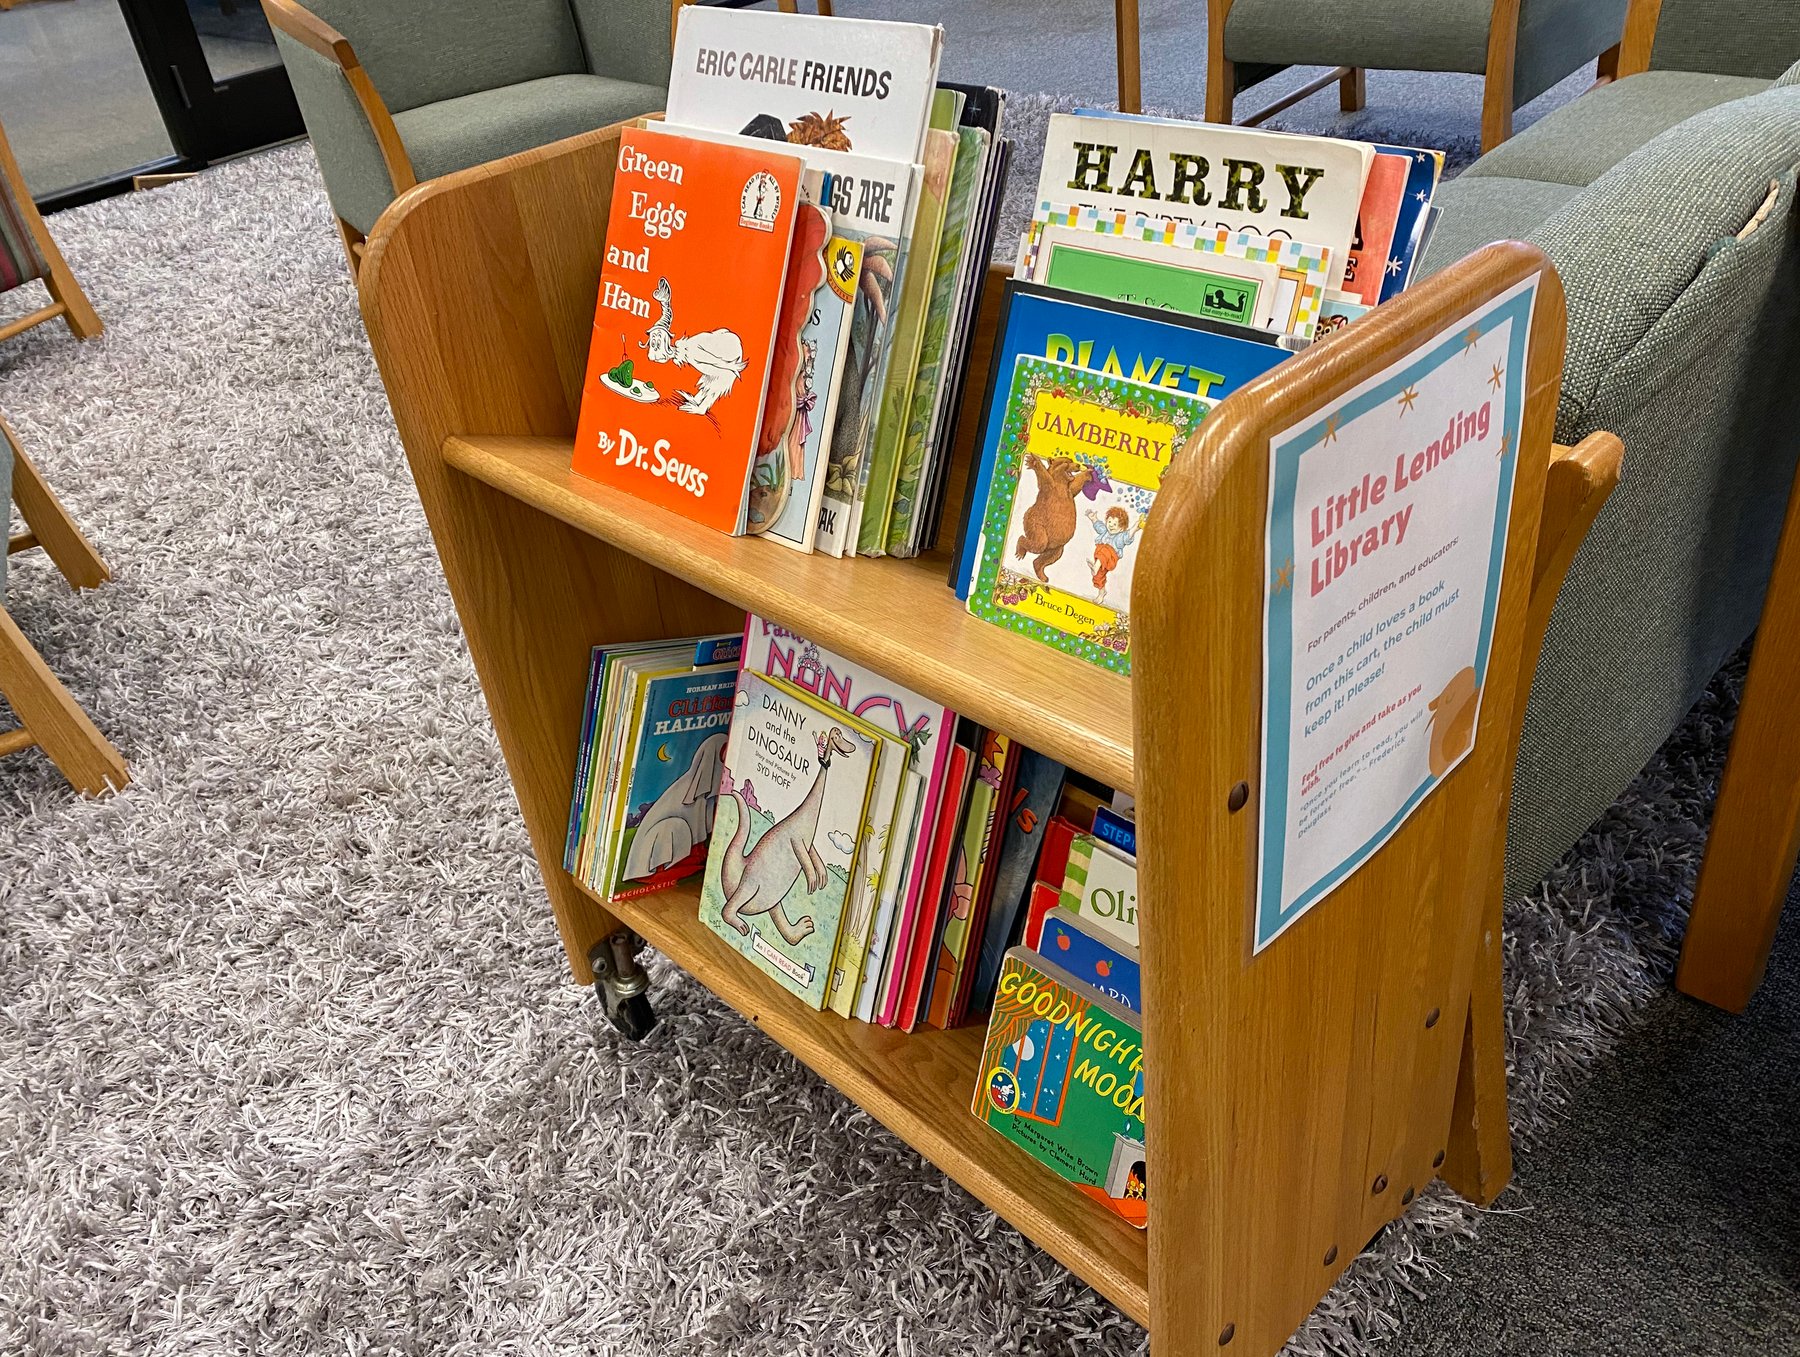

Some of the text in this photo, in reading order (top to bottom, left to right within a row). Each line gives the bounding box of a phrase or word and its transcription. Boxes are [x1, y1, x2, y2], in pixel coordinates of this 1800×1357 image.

[696, 48, 892, 100] ERIC CARLE FRIENDS
[618, 145, 684, 186] Green
[1066, 141, 1325, 220] HARRY
[628, 190, 687, 239] Eggs
[856, 179, 896, 223] ARE
[606, 244, 650, 273] and
[601, 281, 651, 319] Ham
[1036, 411, 1167, 462] JAMBERRY
[598, 428, 709, 498] By Dr. Seuss
[1311, 401, 1491, 548] Little Lending
[1310, 503, 1414, 598] Library
[1034, 592, 1095, 625] Bruce Degen
[1307, 536, 1460, 652] For parents, children, and educators:
[1305, 588, 1460, 716] from this cart, the child must
[1306, 579, 1446, 691] Once a child loves a book
[686, 682, 736, 694] NORMAN BRID
[762, 693, 806, 730] DANNY
[1304, 662, 1386, 738] keep it! Please!
[748, 725, 810, 776] DINOSAUR
[766, 720, 796, 745] and the
[1301, 683, 1422, 786] Feel free to give and take as you
[1324, 774, 1338, 794] you
[1339, 758, 1360, 779] learn
[1361, 750, 1370, 762] to
[1394, 724, 1409, 742] you
[1410, 708, 1424, 724] will
[755, 750, 797, 781] Story and Pictures by
[756, 762, 792, 790] SYD HOFF
[1298, 814, 1308, 827] be
[1309, 788, 1337, 817] forever
[1368, 736, 1406, 768] Frederick
[1300, 776, 1321, 797] wish.
[1102, 822, 1131, 847] STEP
[1298, 804, 1332, 839] Douglass
[621, 880, 676, 898] SCHOLASTIC
[1090, 887, 1139, 925] Oli
[766, 949, 778, 962] CAN
[778, 958, 792, 971] READ
[792, 968, 805, 980] Book
[1000, 972, 1143, 1072] GOODNIGHT
[1073, 1058, 1145, 1123] MOON
[1012, 1123, 1097, 1186] Pictures by Clement Hurd
[1014, 1114, 1099, 1177] by Margaret Wise Brown
